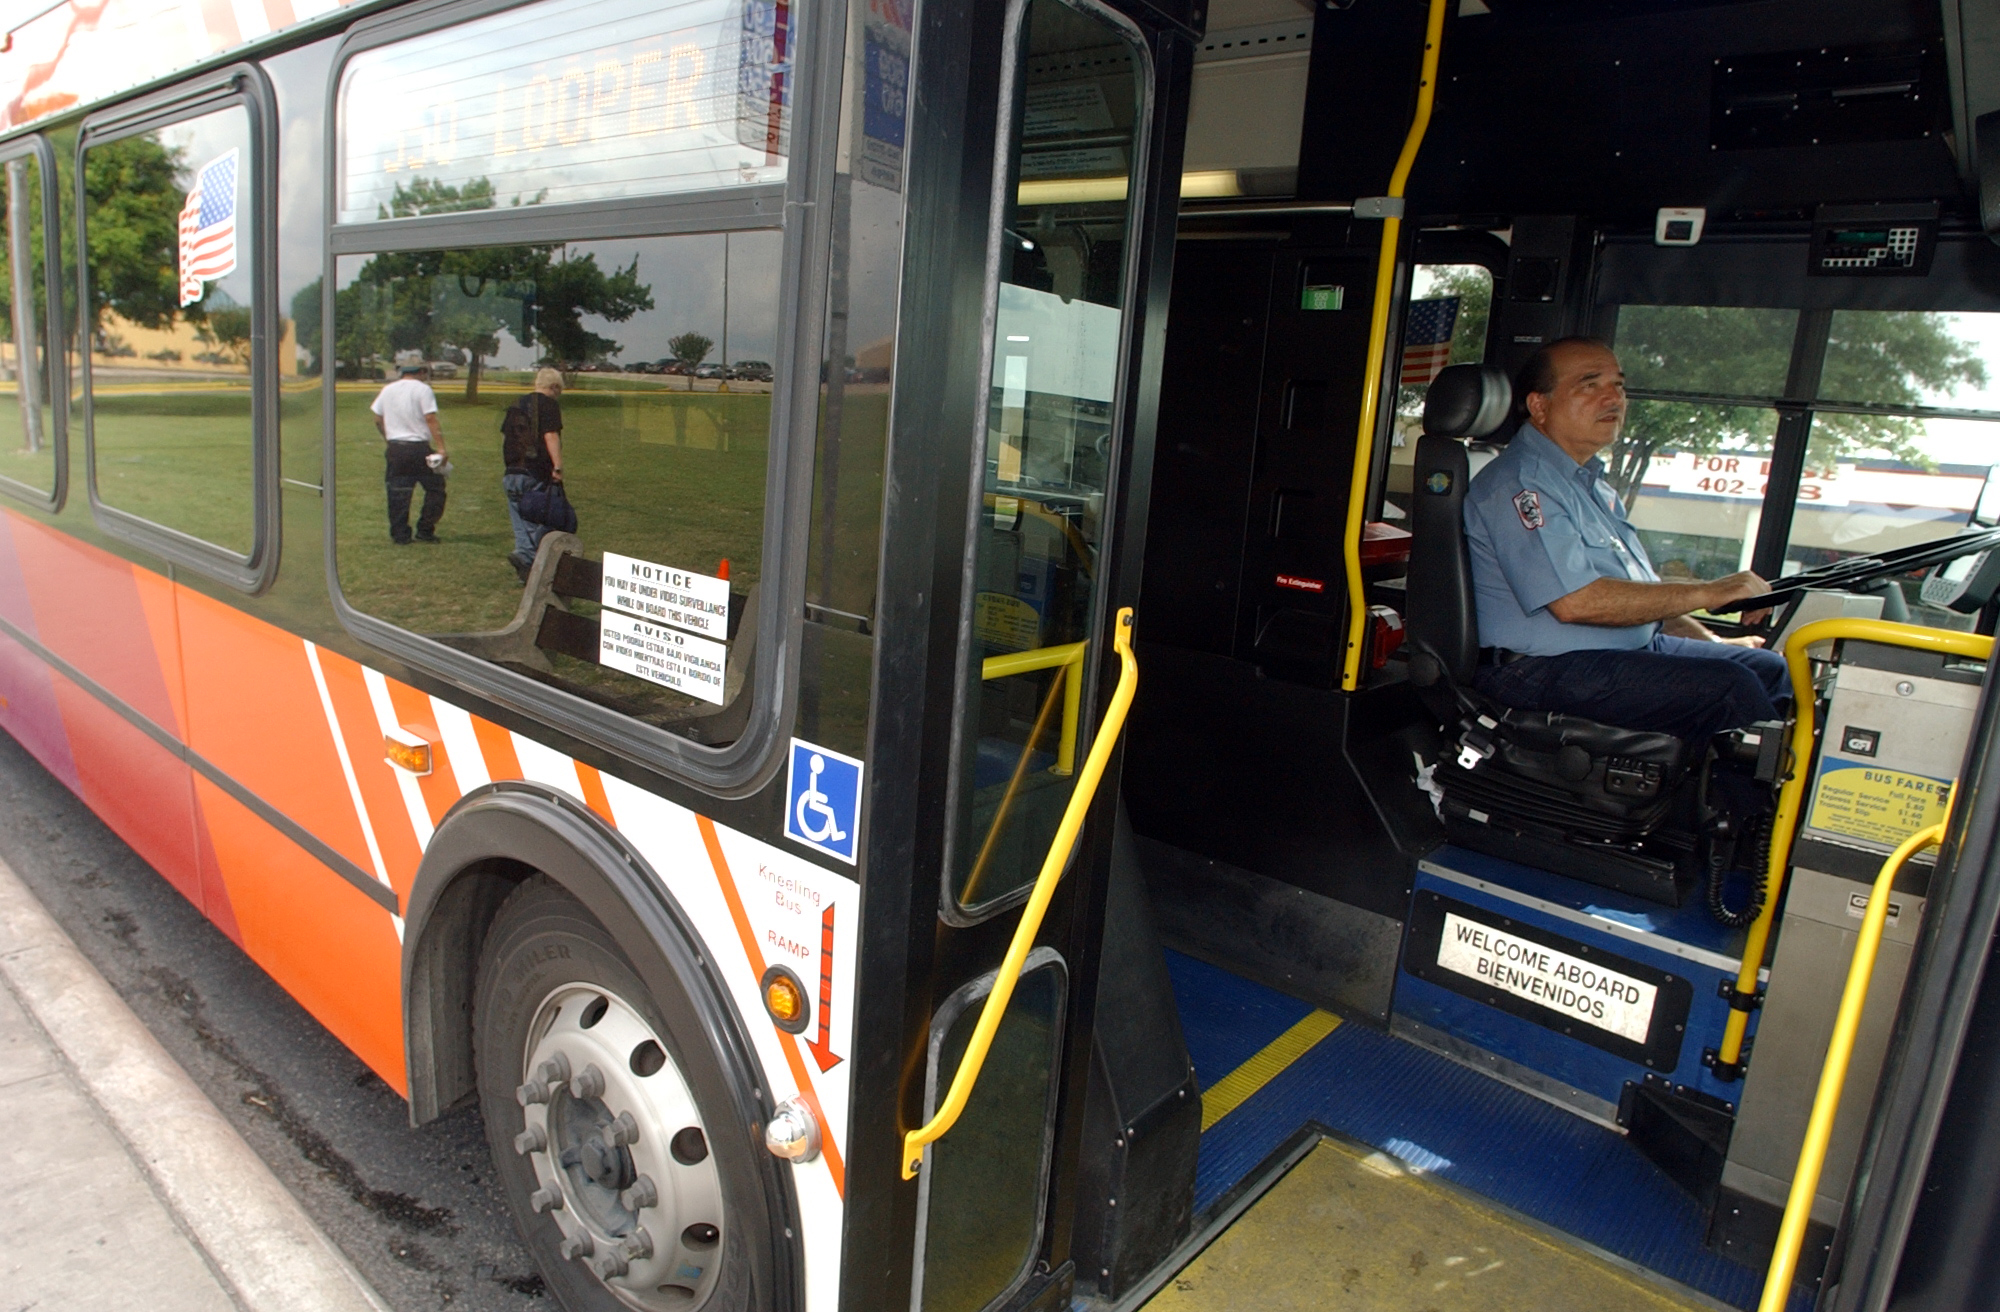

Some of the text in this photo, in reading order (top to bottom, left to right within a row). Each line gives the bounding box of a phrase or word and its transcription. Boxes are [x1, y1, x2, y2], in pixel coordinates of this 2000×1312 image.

[493, 42, 706, 157] LOOPER
[1692, 456, 1740, 474] FOR
[631, 563, 692, 589] NOTICE
[604, 575, 727, 618] YOU MAY BE UNDER VIDEO SURVEILLANCE
[616, 594, 709, 630] WHILE ON BOARD THIS VEHICLE
[633, 623, 685, 646] AVISO
[602, 640, 614, 651] CON
[615, 645, 633, 658] VIDEO
[633, 650, 665, 669] MIENTRAS
[713, 675, 721, 687] DE
[603, 628, 621, 641] USTED
[646, 638, 665, 655] ESTAR
[666, 643, 682, 660] BAJO
[683, 648, 721, 672] VIGILANCIA
[1822, 784, 1855, 797] Regular
[1858, 792, 1890, 804] Service
[1864, 770, 1946, 796] BUS FARES
[1819, 800, 1852, 813] Transfer
[1854, 808, 1870, 818] Slip
[1820, 792, 1851, 805] Express
[1855, 800, 1887, 813] Service
[1888, 790, 1927, 805] Full Fare
[759, 863, 821, 907] Kneeling
[775, 891, 802, 915] Bus
[768, 929, 810, 960] RAMP
[1456, 923, 1640, 1005] WELCOME ABOARD
[1476, 957, 1605, 1019] BIENVENIDOS
